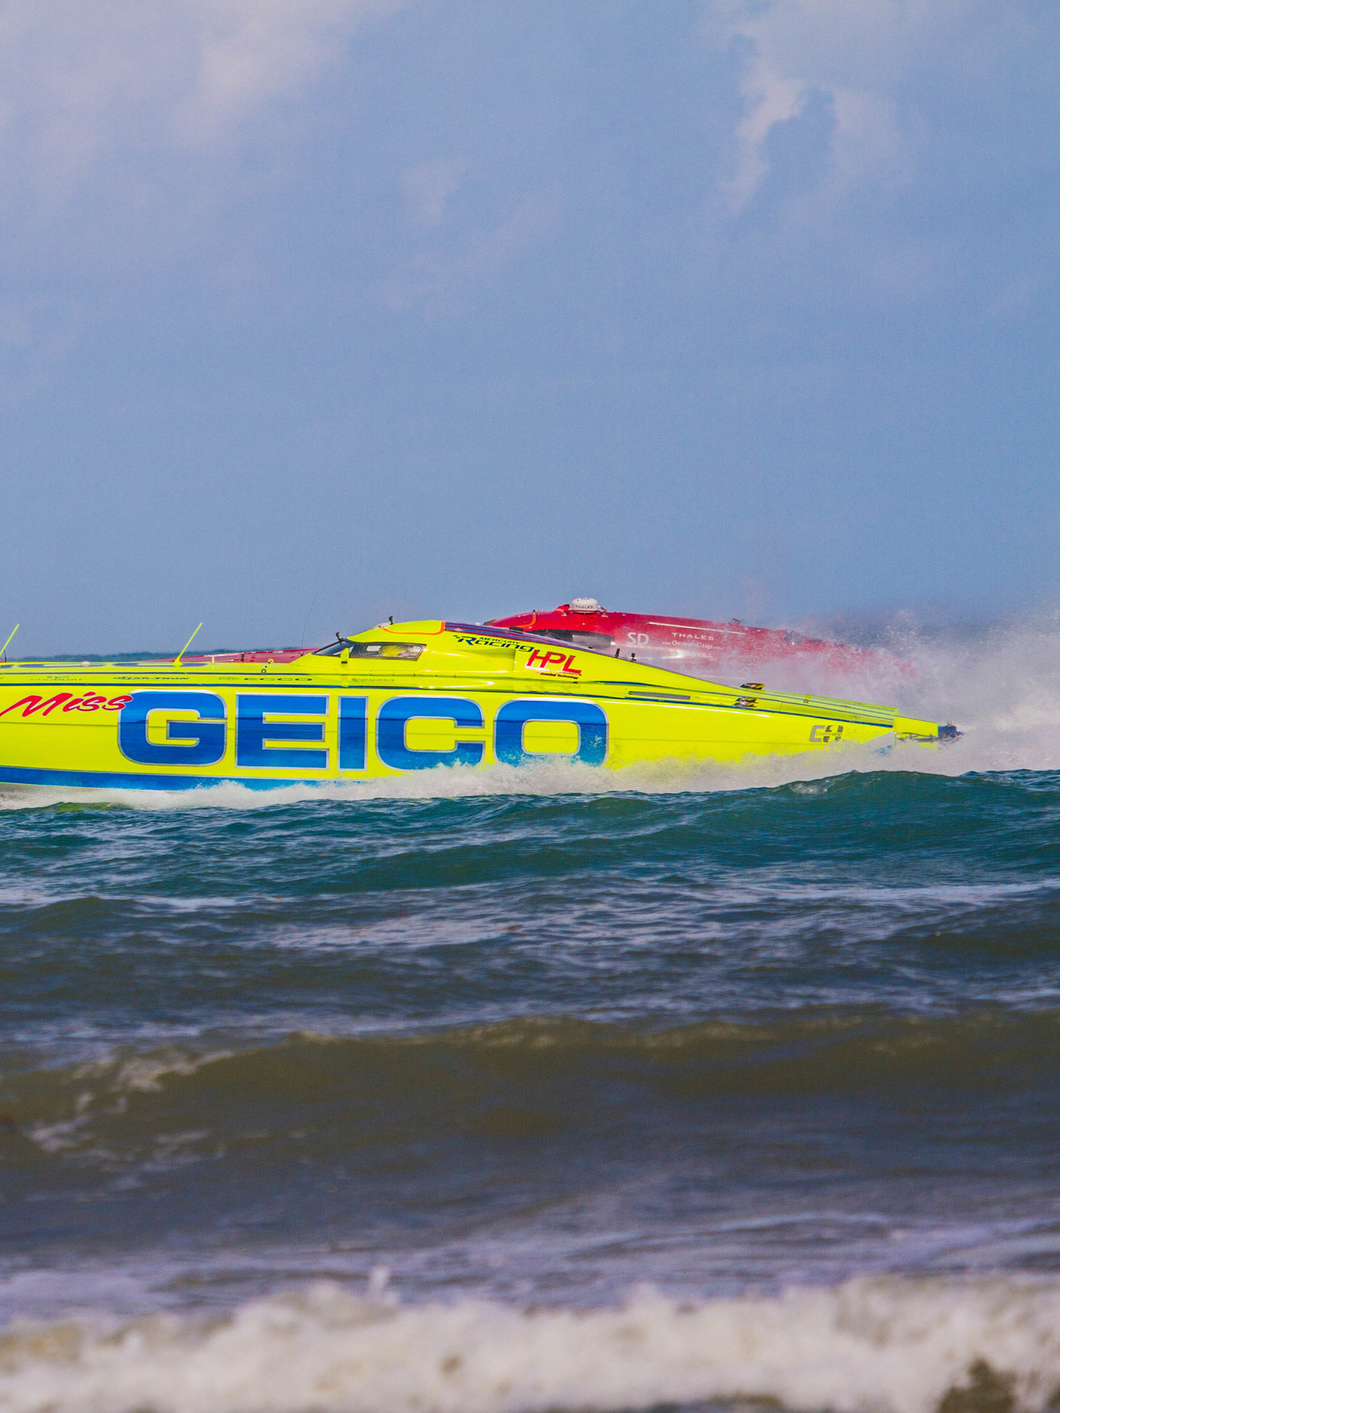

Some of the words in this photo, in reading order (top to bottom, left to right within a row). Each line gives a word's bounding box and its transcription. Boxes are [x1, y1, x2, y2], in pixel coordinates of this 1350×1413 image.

[457, 636, 535, 652] Racing
[626, 632, 650, 646] SD
[671, 632, 715, 641] THALES
[526, 650, 582, 674] HPL
[117, 689, 609, 770] GEICO
